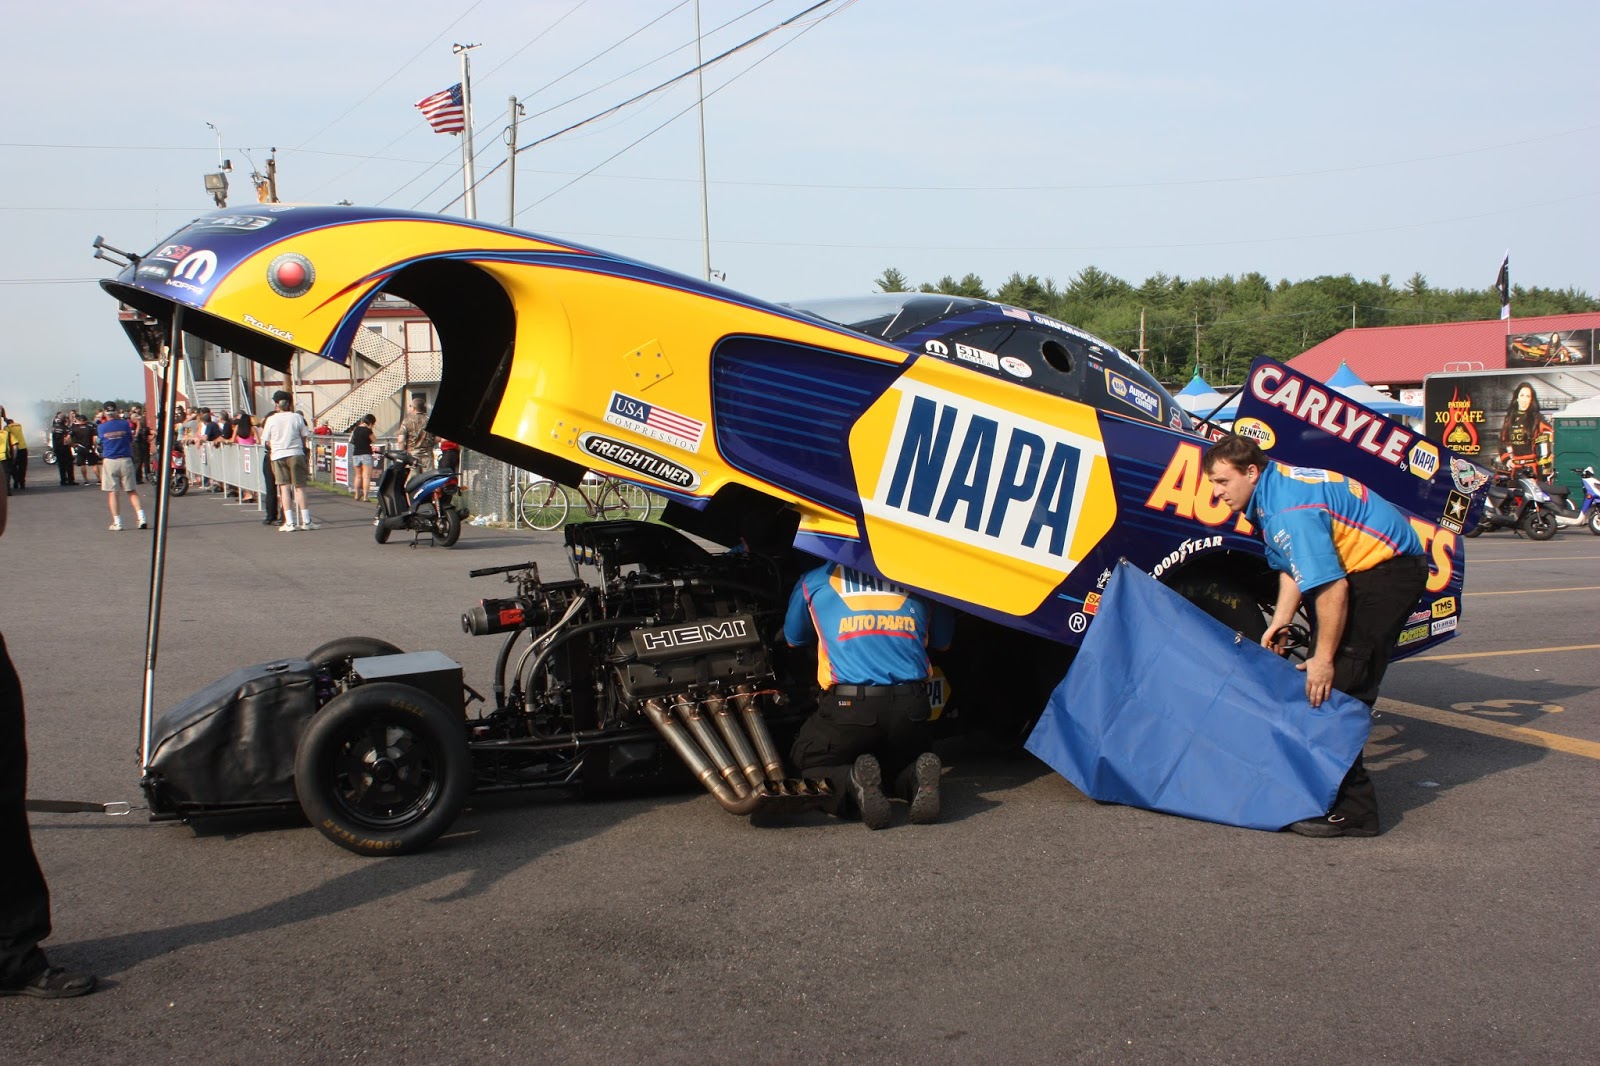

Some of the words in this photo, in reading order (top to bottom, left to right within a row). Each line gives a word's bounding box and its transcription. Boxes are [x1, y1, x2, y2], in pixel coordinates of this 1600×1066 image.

[166, 278, 204, 295] MOPAR
[959, 345, 983, 359] 5.11
[615, 397, 645, 420] USA
[1252, 364, 1414, 465] CARLYLE
[1434, 411, 1450, 423] XO
[606, 414, 697, 452] COMPRESSION
[1239, 425, 1270, 441] PENNZOIL
[588, 438, 691, 485] FREIGHTLINER
[1399, 460, 1409, 472] by
[1412, 448, 1436, 473] NAPA
[885, 395, 1081, 557] NAPA
[1147, 535, 1223, 580] OODYEAR
[1434, 600, 1452, 612] TMS
[643, 620, 746, 650] HEMI
[838, 614, 876, 634] AUTO
[877, 614, 916, 632] PARTS
